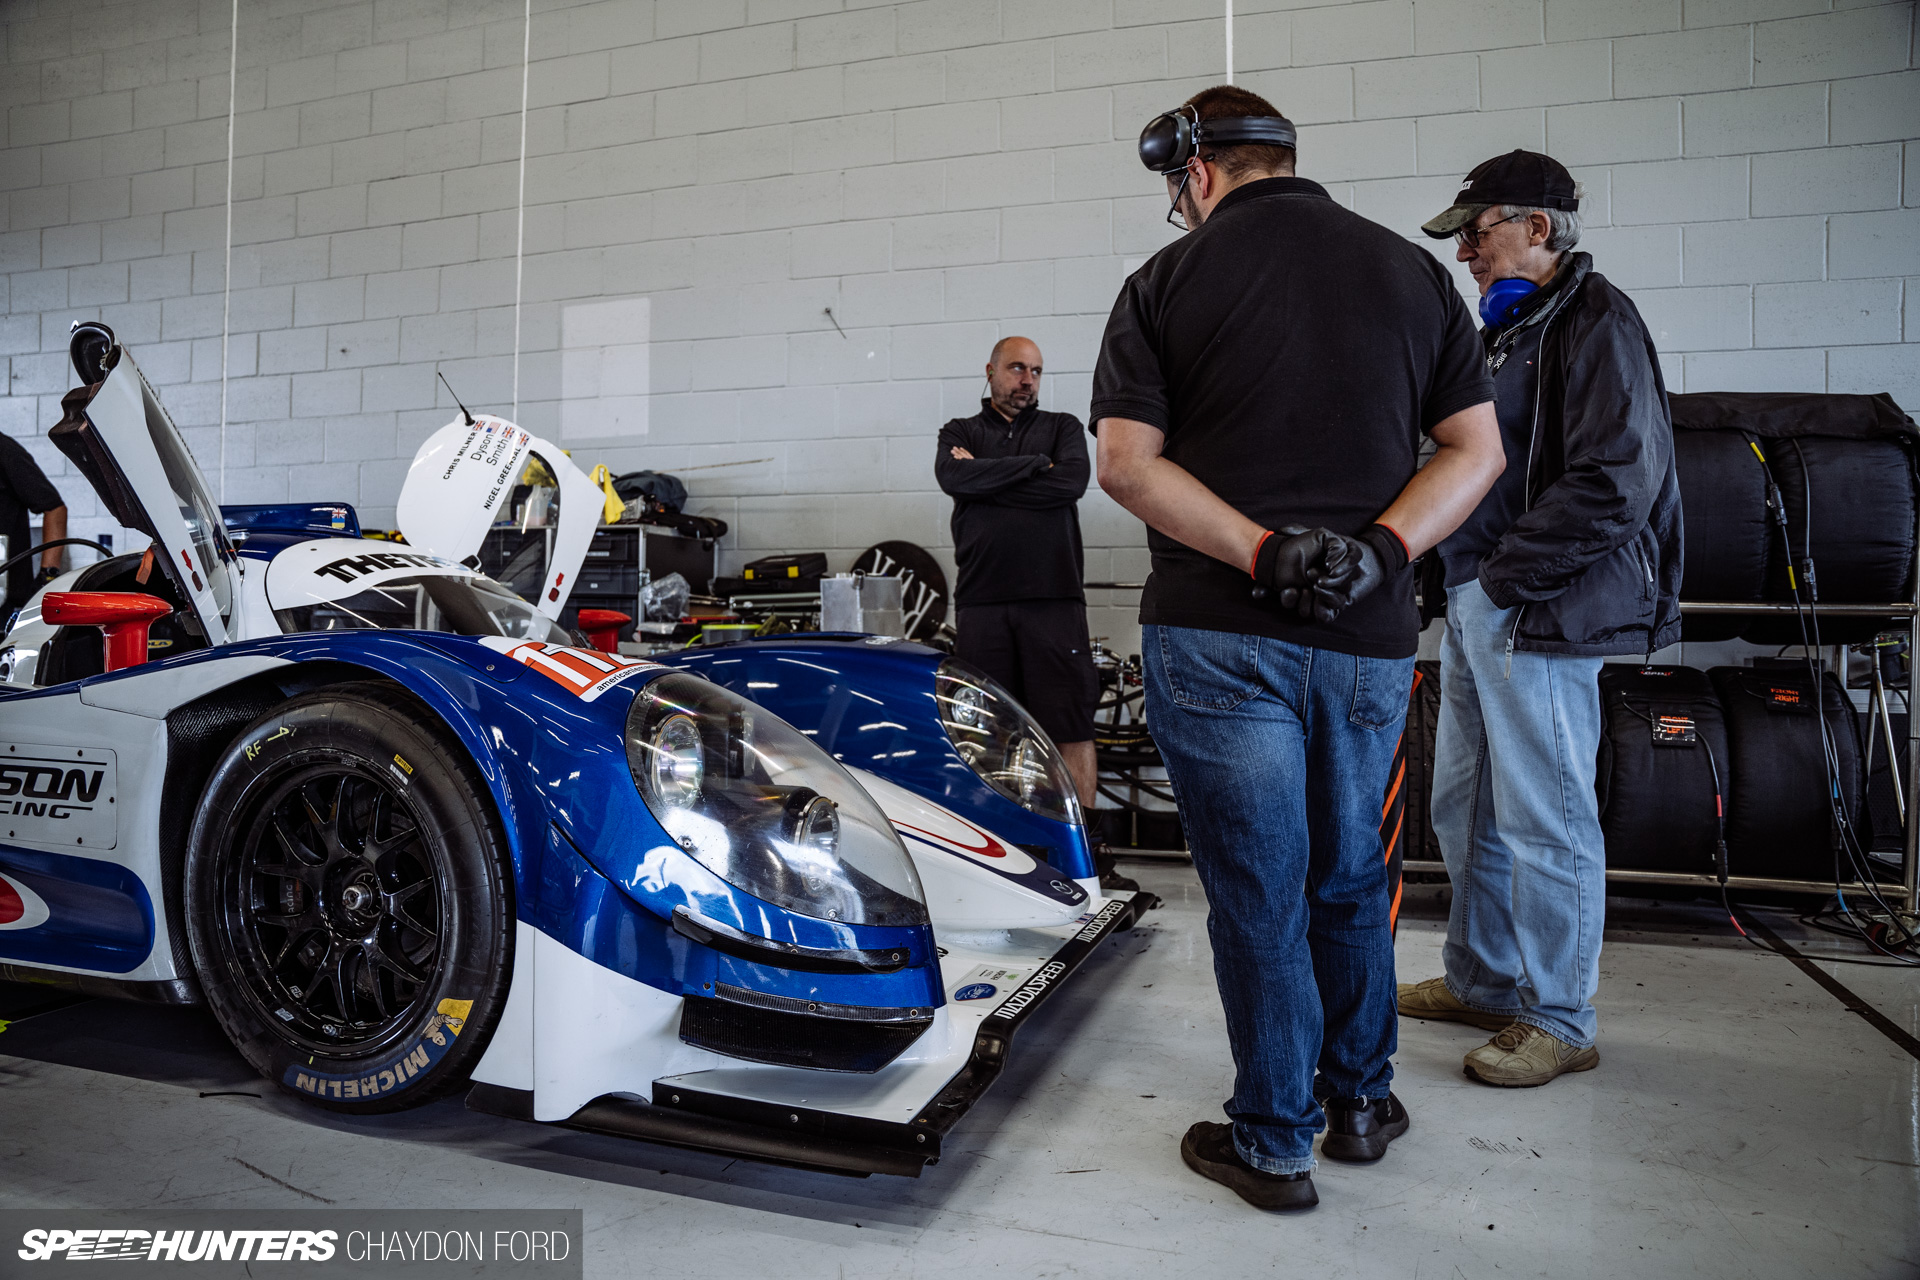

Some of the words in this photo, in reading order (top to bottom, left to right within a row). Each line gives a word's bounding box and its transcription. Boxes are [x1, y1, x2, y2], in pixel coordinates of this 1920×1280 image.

[443, 458, 460, 480] CHRIS
[457, 432, 477, 458] MILNER
[470, 434, 494, 462] Dyson
[486, 438, 509, 466] Smith
[483, 486, 501, 510] NIGEL
[1774, 694, 1800, 703] RIGHT
[1666, 726, 1686, 734] LEFT
[245, 740, 262, 761] RF
[1076, 901, 1125, 943] MAZDASPEED
[994, 961, 1067, 1020] MAZDASPEED
[295, 1044, 431, 1099] MICHELIN
